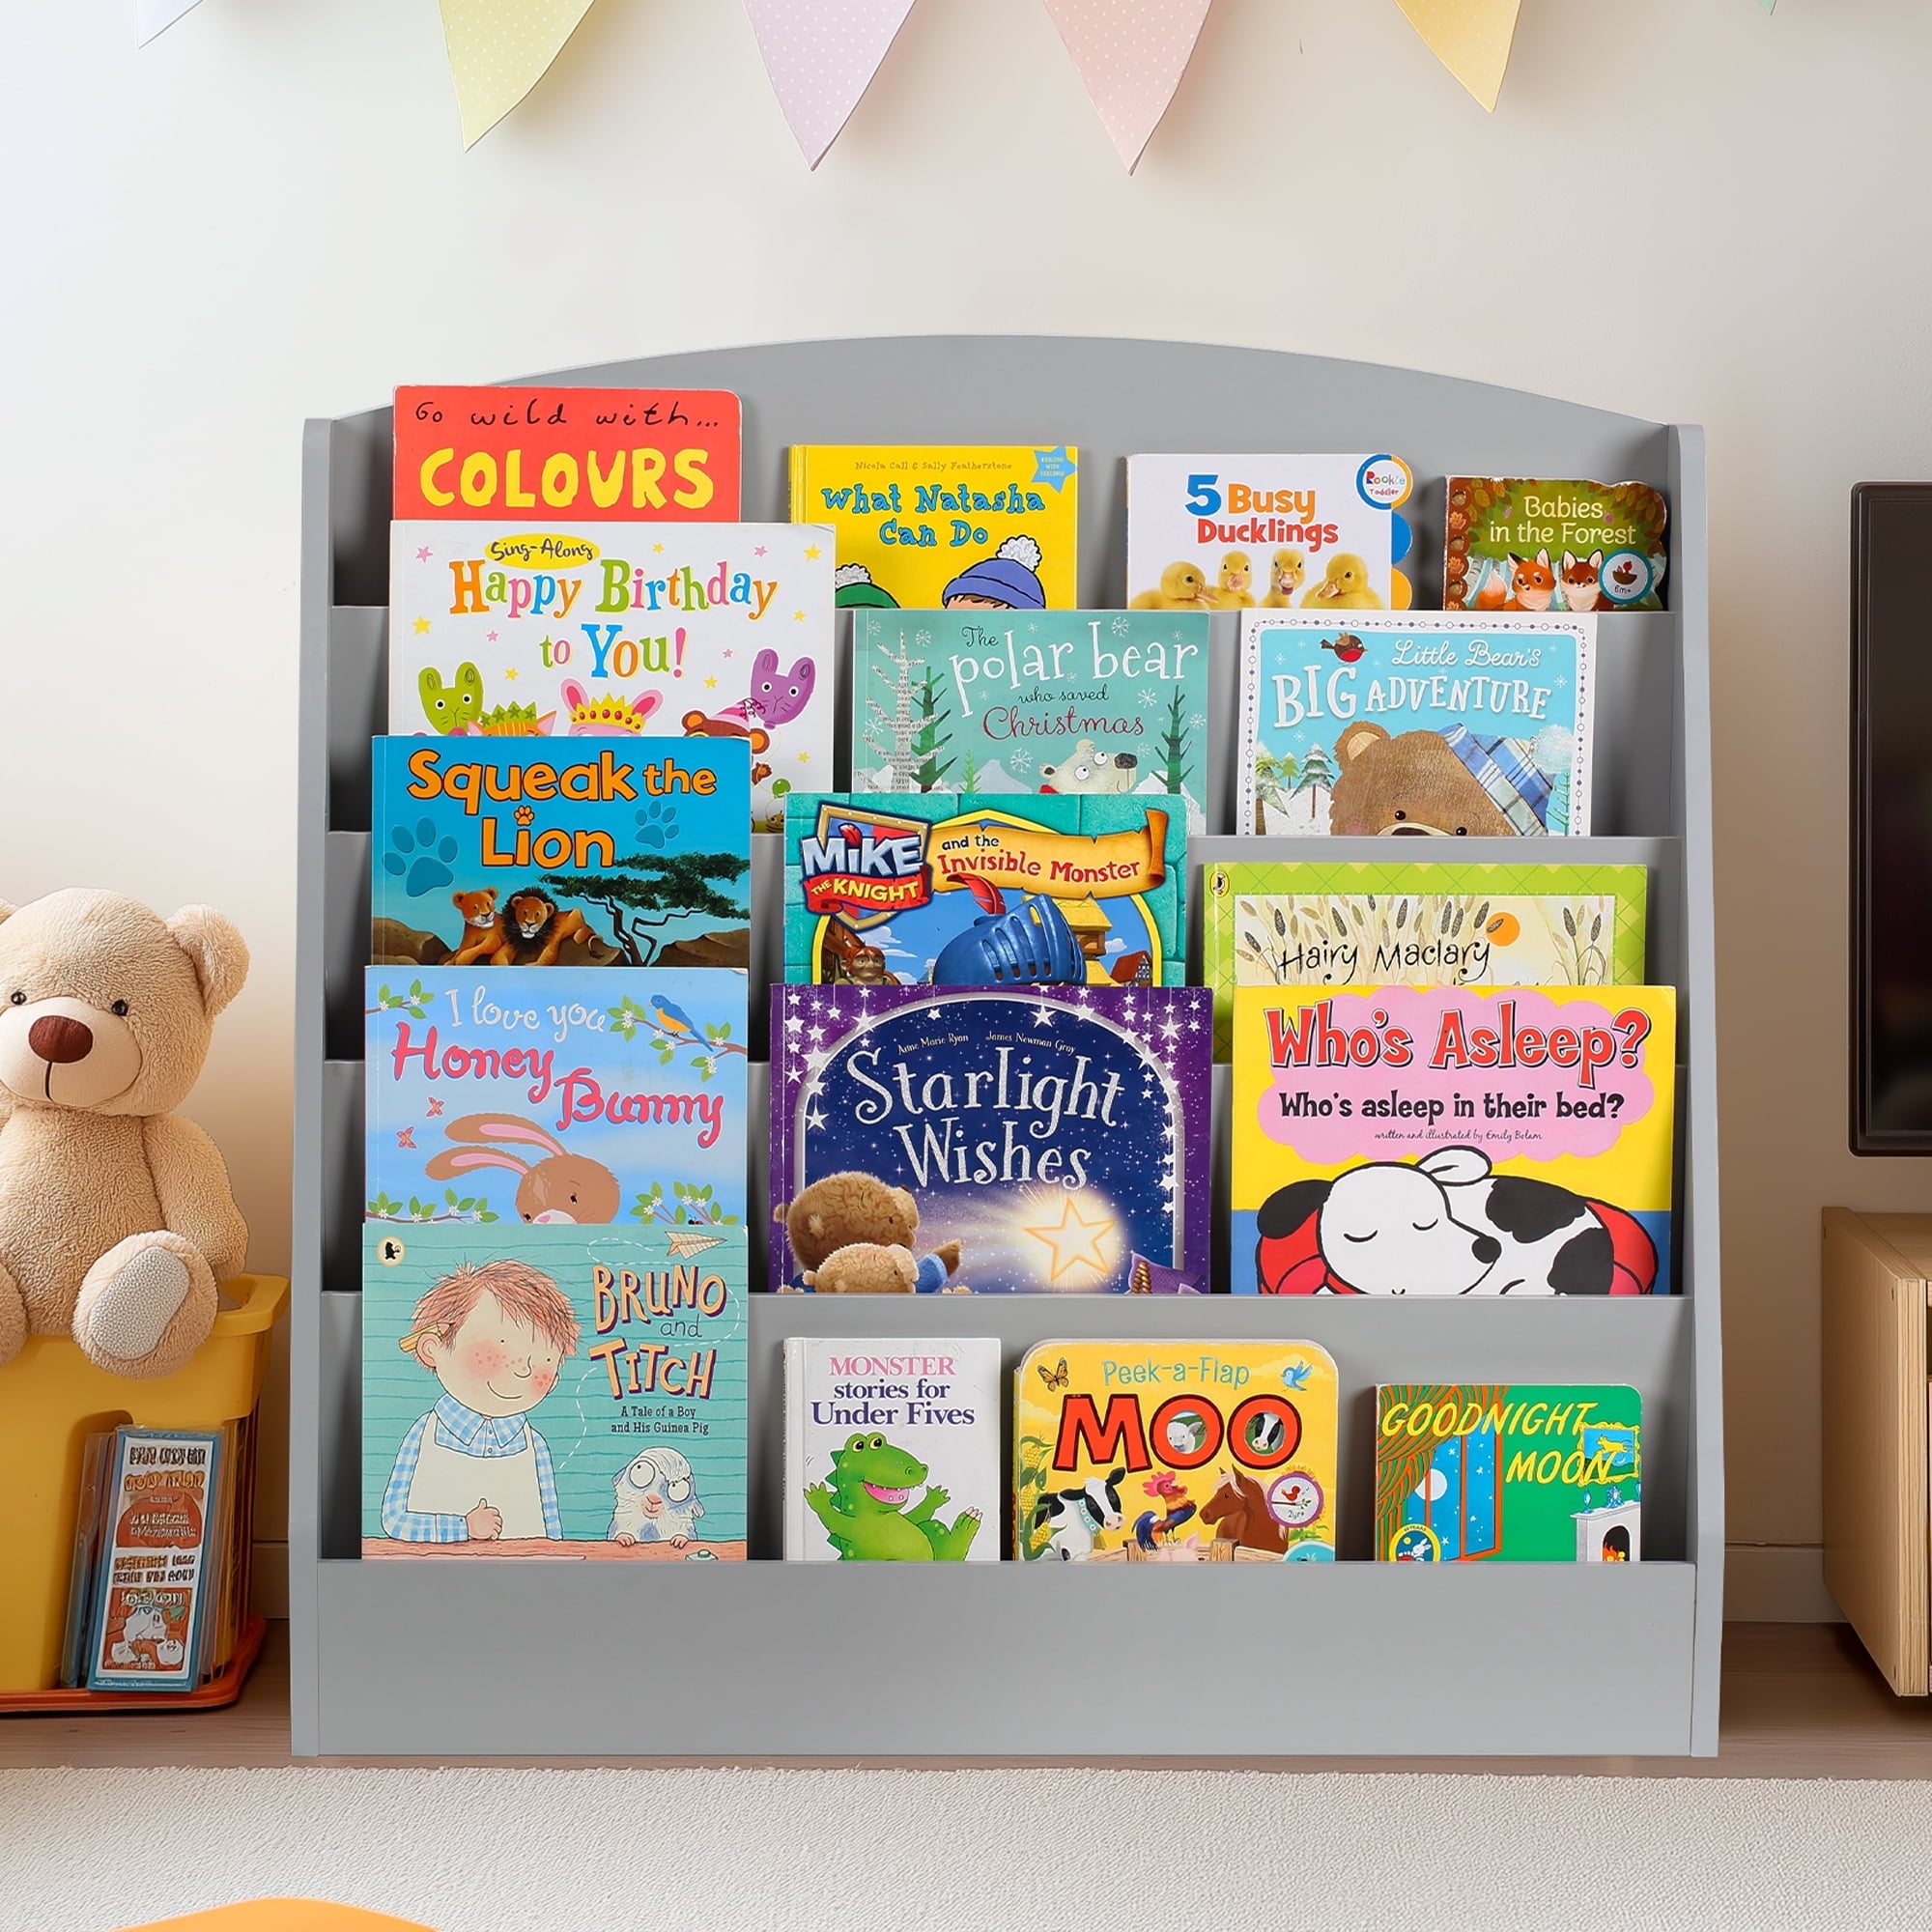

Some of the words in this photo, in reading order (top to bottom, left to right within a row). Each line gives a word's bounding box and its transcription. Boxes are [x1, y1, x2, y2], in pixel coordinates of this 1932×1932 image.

[415, 401, 443, 423] Go
[470, 399, 567, 426] wild
[420, 447, 714, 510] COLOURS
[855, 461, 886, 470] Nicola
[890, 461, 908, 470] Call
[922, 461, 947, 472] Sally
[951, 461, 1012, 470] Featherstone
[1366, 470, 1406, 485] Rookie
[821, 483, 902, 515] What
[915, 483, 1046, 515] Natasha
[1185, 473, 1220, 517] 5
[1228, 482, 1316, 524] Busy
[1523, 495, 1604, 521] Babies
[879, 519, 937, 547] Can
[950, 520, 989, 547] Do
[1196, 518, 1339, 554] Ducklings
[1490, 522, 1512, 543] in
[1516, 522, 1555, 544] the
[1561, 523, 1637, 546] Forest
[490, 538, 594, 562] Sing-Along
[449, 559, 582, 618] Happy
[595, 558, 778, 620] Birthday
[539, 634, 571, 668] to
[582, 623, 688, 679] You!
[961, 626, 999, 648] The
[1391, 639, 1459, 668] Little
[1464, 639, 1542, 668] Bear's
[949, 630, 1074, 719] polar
[1087, 621, 1199, 680] bear
[1018, 687, 1057, 705] who
[1060, 684, 1109, 704] saved
[1271, 665, 1357, 729] BIG
[1364, 675, 1552, 721] ADVENTURE
[982, 706, 1145, 741] Christmas
[407, 749, 639, 815] Squeak
[642, 757, 718, 795] the
[481, 806, 615, 868] Lion
[941, 836, 969, 850] and
[975, 835, 999, 848] the
[937, 850, 1041, 876] Invisible
[1049, 860, 1141, 883] Monster
[810, 879, 833, 896] THE
[832, 878, 920, 902] KNIGHT
[1278, 940, 1358, 985] Hairy
[1373, 939, 1491, 982] Maclary
[445, 988, 462, 1027] I
[472, 985, 540, 1030] love
[547, 1003, 605, 1042] you
[897, 1043, 919, 1056] Anne
[921, 1036, 946, 1048] Marie
[948, 1033, 969, 1046] Ryan
[985, 1030, 1013, 1041] James
[1015, 1033, 1052, 1047] Newman
[1055, 1039, 1076, 1056] Gray
[1264, 1000, 1414, 1068] Who's
[1428, 1000, 1652, 1090] Asleep?
[391, 1021, 554, 1103] Honey
[554, 1067, 724, 1149] Bunny
[847, 1046, 1125, 1139] Starlight
[1279, 1093, 1352, 1119] Who's
[1361, 1090, 1444, 1124] asleep
[1454, 1093, 1475, 1118] in
[1483, 1093, 1547, 1118] their
[1556, 1093, 1625, 1119] bed?
[1375, 1129, 1406, 1140] written
[1406, 1129, 1423, 1140] and
[1425, 1129, 1471, 1140] illustrated
[1473, 1130, 1483, 1144] by
[1486, 1129, 1512, 1144] Emily
[893, 1117, 1092, 1191] Wishes
[592, 1264, 727, 1335] BRUNO
[661, 1314, 702, 1338] and
[588, 1338, 718, 1401] TITCH
[829, 1356, 955, 1376] MONSTER
[1102, 1356, 1250, 1390] Peek-a-Flap
[834, 1379, 908, 1399] stories
[917, 1378, 950, 1399] for
[611, 1422, 630, 1433] and
[633, 1422, 650, 1433] His
[653, 1422, 690, 1433] Guinea
[693, 1422, 709, 1435] Pig
[621, 1406, 628, 1417] A
[631, 1406, 653, 1417] Tale
[656, 1406, 667, 1417] of
[668, 1408, 674, 1417] a
[677, 1406, 696, 1419] Boy
[810, 1402, 898, 1425] Under
[906, 1402, 975, 1425] Fives
[1381, 1403, 1599, 1436] GOODNIGHT
[1052, 1394, 1302, 1473] MOO
[1505, 1450, 1617, 1485] MOON
